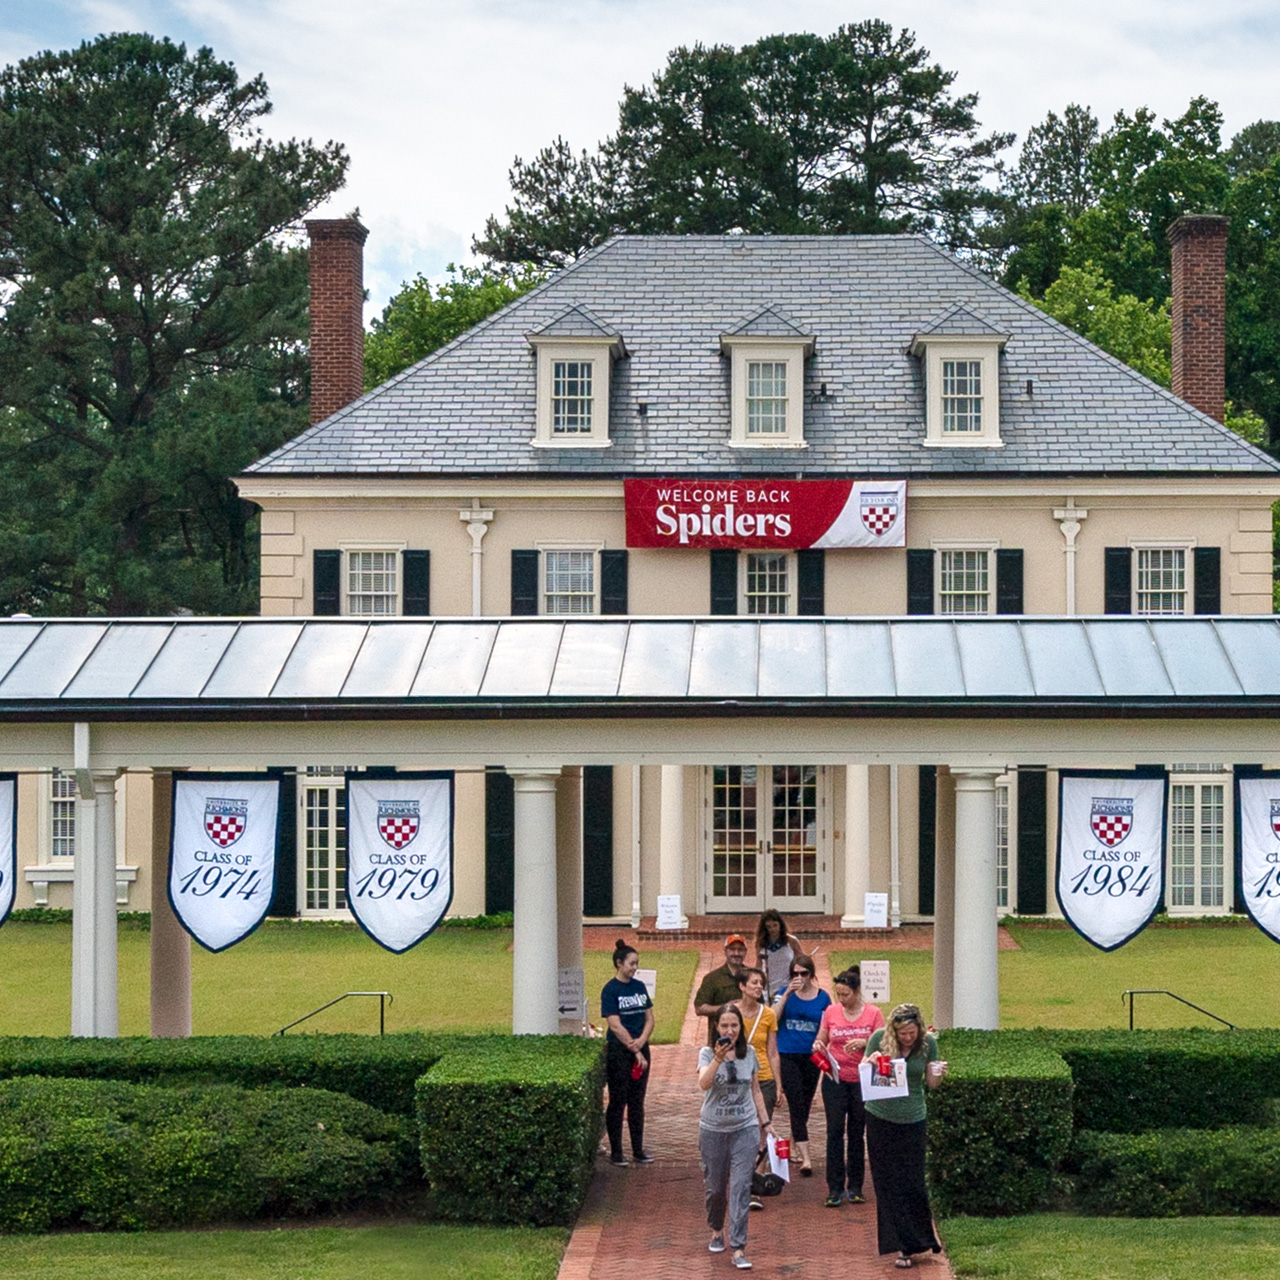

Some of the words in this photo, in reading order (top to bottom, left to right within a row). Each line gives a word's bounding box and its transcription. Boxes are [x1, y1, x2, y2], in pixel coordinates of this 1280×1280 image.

[657, 489, 739, 503] WELCOME
[746, 490, 790, 503] BACK
[655, 503, 792, 544] Spiders
[206, 804, 248, 813] RICHMOND
[378, 806, 420, 815] RICHMOND
[1092, 804, 1133, 813] RICHMOND
[194, 851, 231, 864] CLASS
[235, 855, 252, 865] OF
[369, 854, 406, 865] CLASS
[410, 854, 426, 865] OF
[1083, 850, 1120, 861] CLASS
[1124, 852, 1140, 862] OF
[180, 865, 261, 900] 1974
[356, 868, 439, 900] 1979
[1072, 864, 1153, 897] 1984
